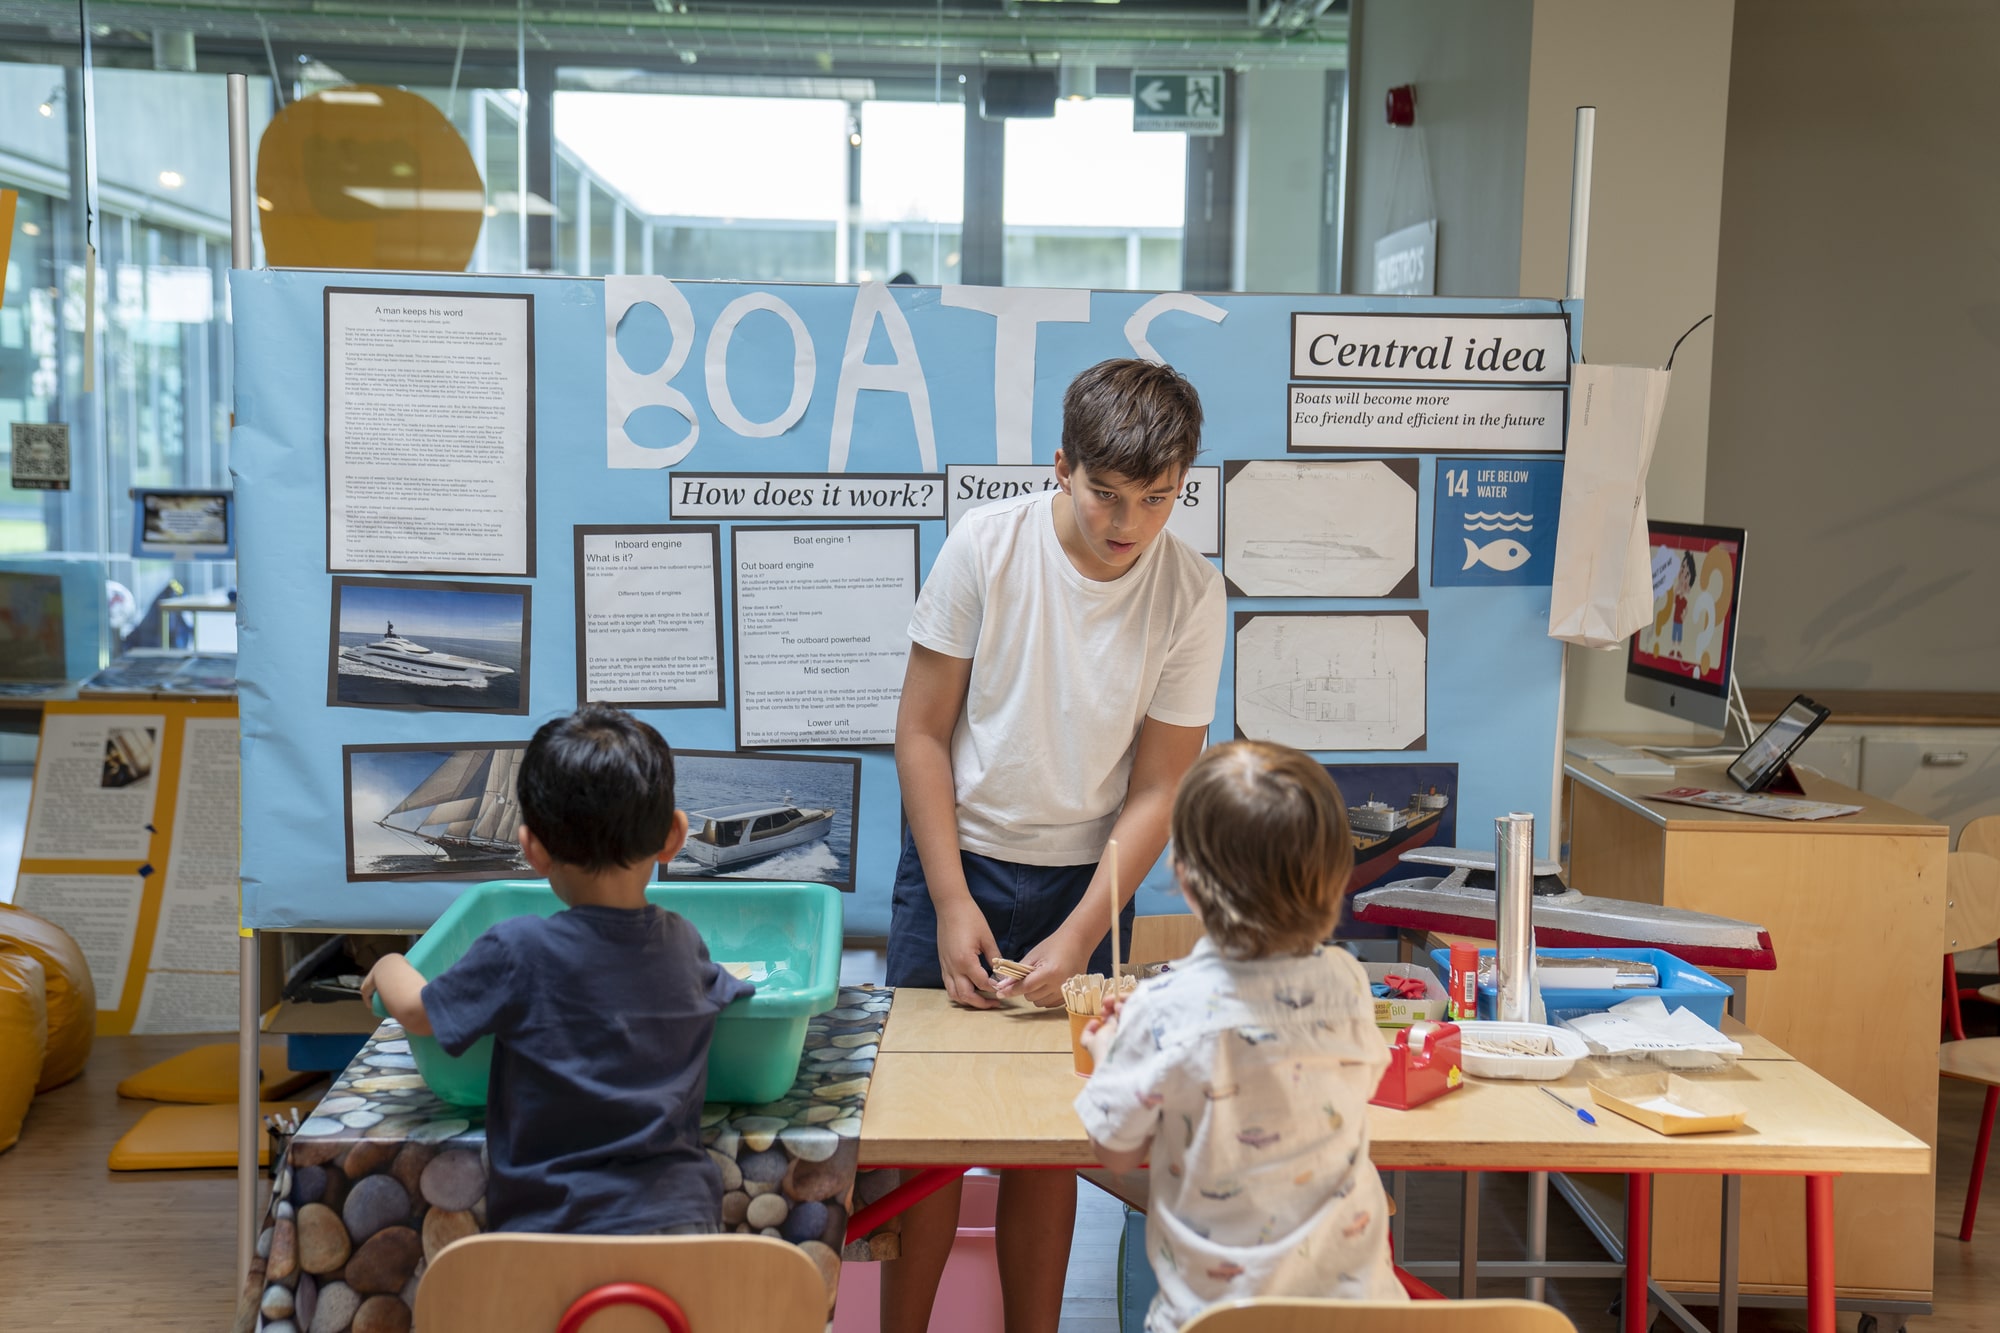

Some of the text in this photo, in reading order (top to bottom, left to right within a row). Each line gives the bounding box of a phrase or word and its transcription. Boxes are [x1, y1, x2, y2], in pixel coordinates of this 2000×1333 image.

[375, 306, 381, 314] A
[402, 307, 427, 317] keeps
[429, 308, 441, 316] his
[443, 309, 464, 317] word
[1309, 333, 1546, 372] Central idea
[1294, 392, 1450, 406] Boats will become more
[1294, 411, 1545, 428] Eco friendly and efficient in the future
[1446, 469, 1529, 497] 14 LIFE BELOW
[679, 481, 934, 507] How does it work?
[1477, 485, 1507, 498] WATER
[615, 540, 682, 550] Inboard engine
[794, 535, 851, 545] Boat engine 1
[586, 554, 610, 562] What
[622, 553, 634, 561] it?
[785, 562, 814, 571] engine
[830, 636, 871, 644] powerhead
[1391, 1005, 1406, 1016] BIO
